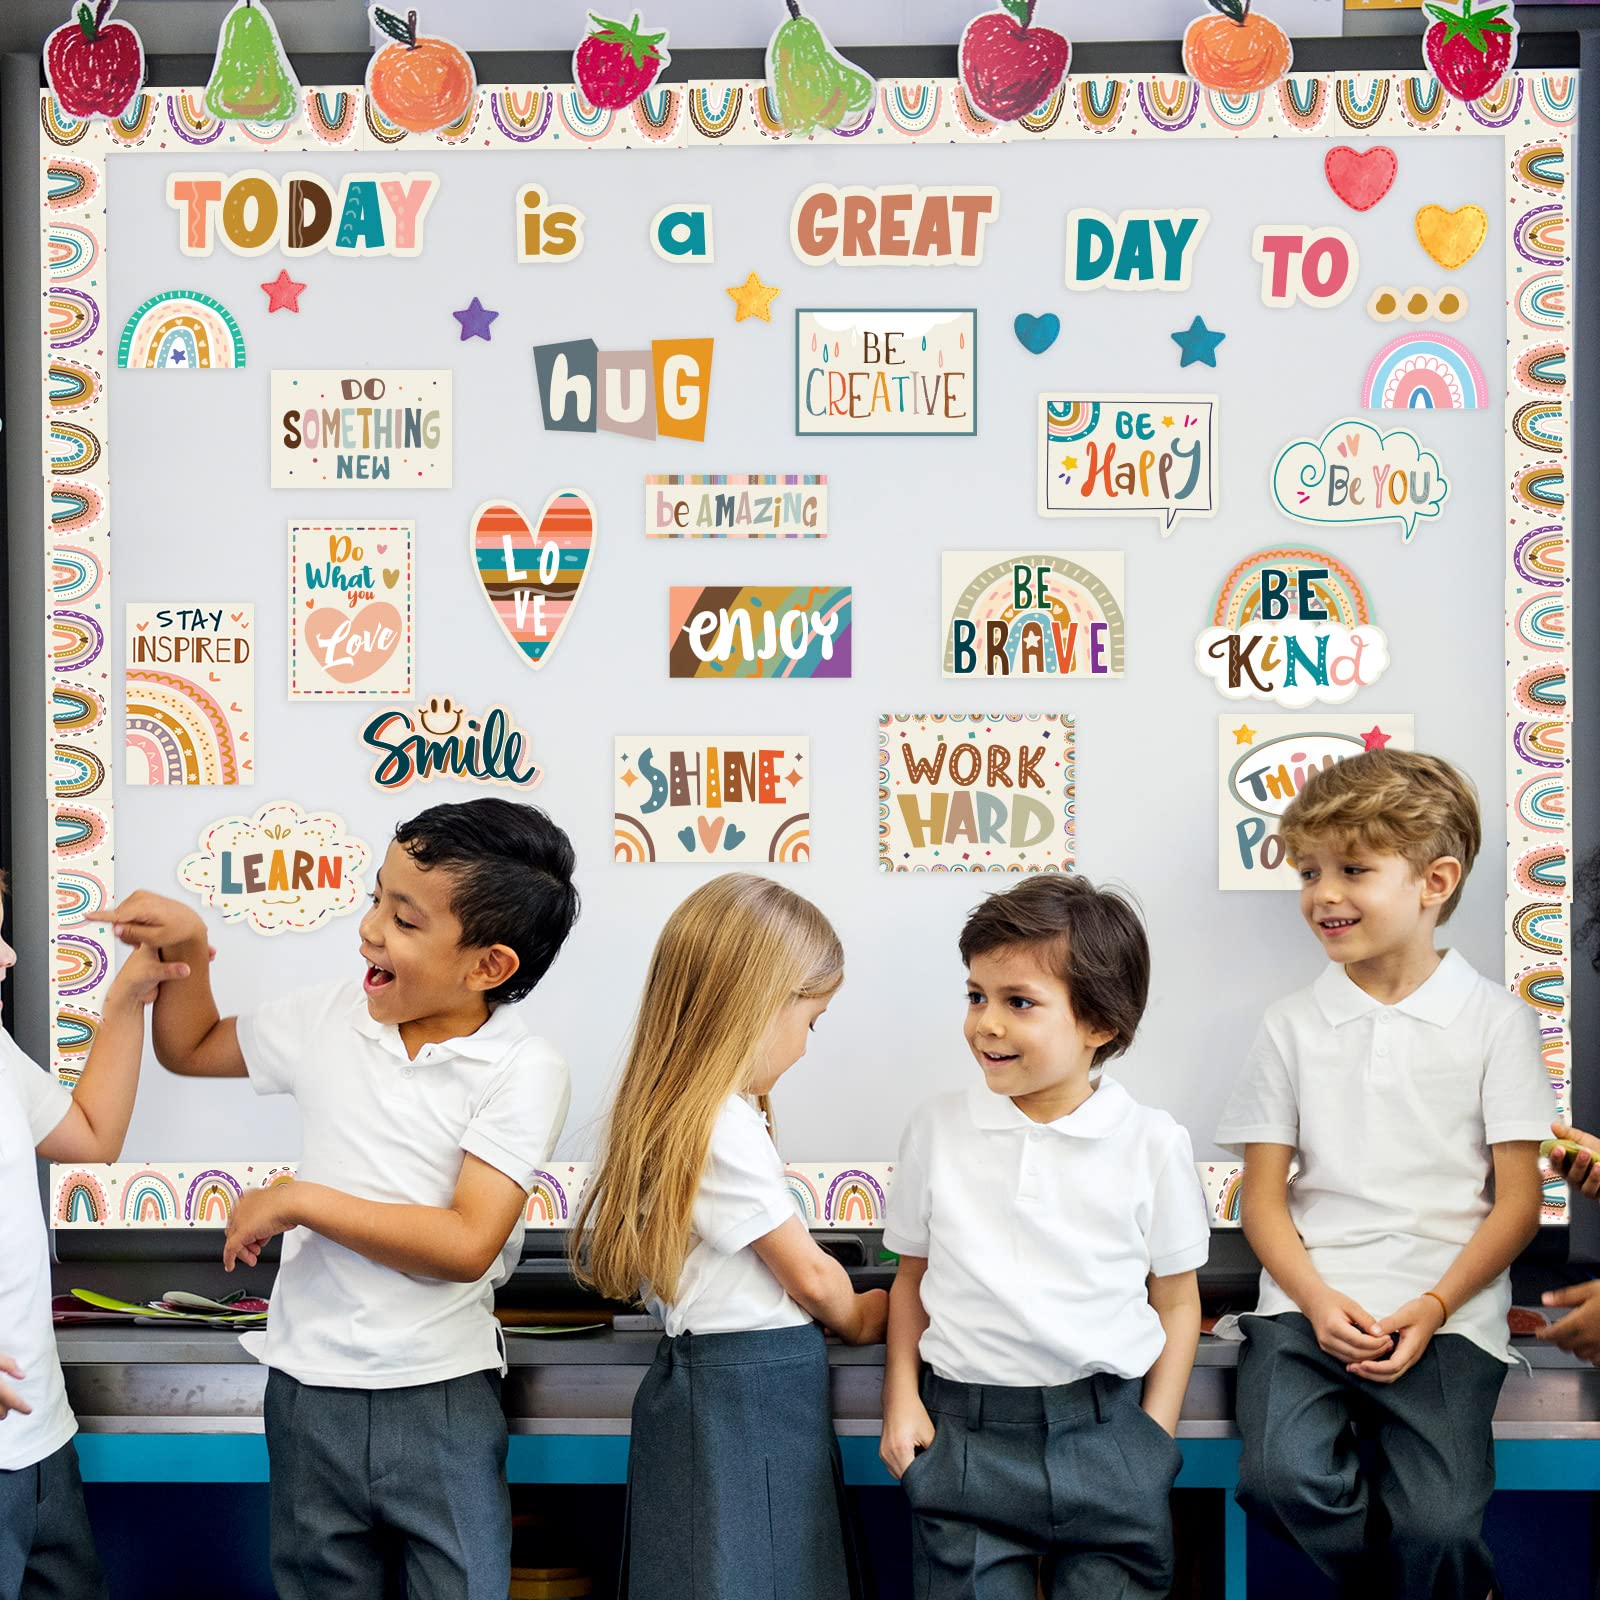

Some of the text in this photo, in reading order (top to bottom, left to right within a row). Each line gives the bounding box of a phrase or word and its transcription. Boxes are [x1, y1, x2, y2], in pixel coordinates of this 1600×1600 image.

[174, 177, 432, 248] TODAY
[524, 190, 577, 255] is
[657, 212, 706, 255] a
[797, 192, 993, 257] GREAT
[1076, 217, 1199, 281] DAY
[1262, 235, 1349, 297] TO
[863, 331, 905, 365] BE
[341, 378, 385, 400] DO
[806, 368, 966, 418] CREATIVE
[283, 407, 441, 449] SOMETHING
[1115, 411, 1155, 440] BE
[336, 455, 390, 480] NEW
[1373, 464, 1430, 508] YOU
[656, 491, 689, 527] be
[329, 535, 363, 563] Do
[305, 562, 375, 591] What
[347, 589, 375, 608] you
[1014, 565, 1051, 609] BE
[1261, 569, 1329, 621] BE
[156, 608, 223, 632] STAY
[132, 636, 250, 664] INSPIRED
[316, 619, 399, 672] Love
[954, 620, 1107, 675] BRAVE
[363, 708, 537, 788] Smile
[902, 743, 1046, 788] WORK
[638, 747, 786, 814] SHINE
[897, 791, 1055, 848] HARD
[221, 849, 342, 895] LEARN
